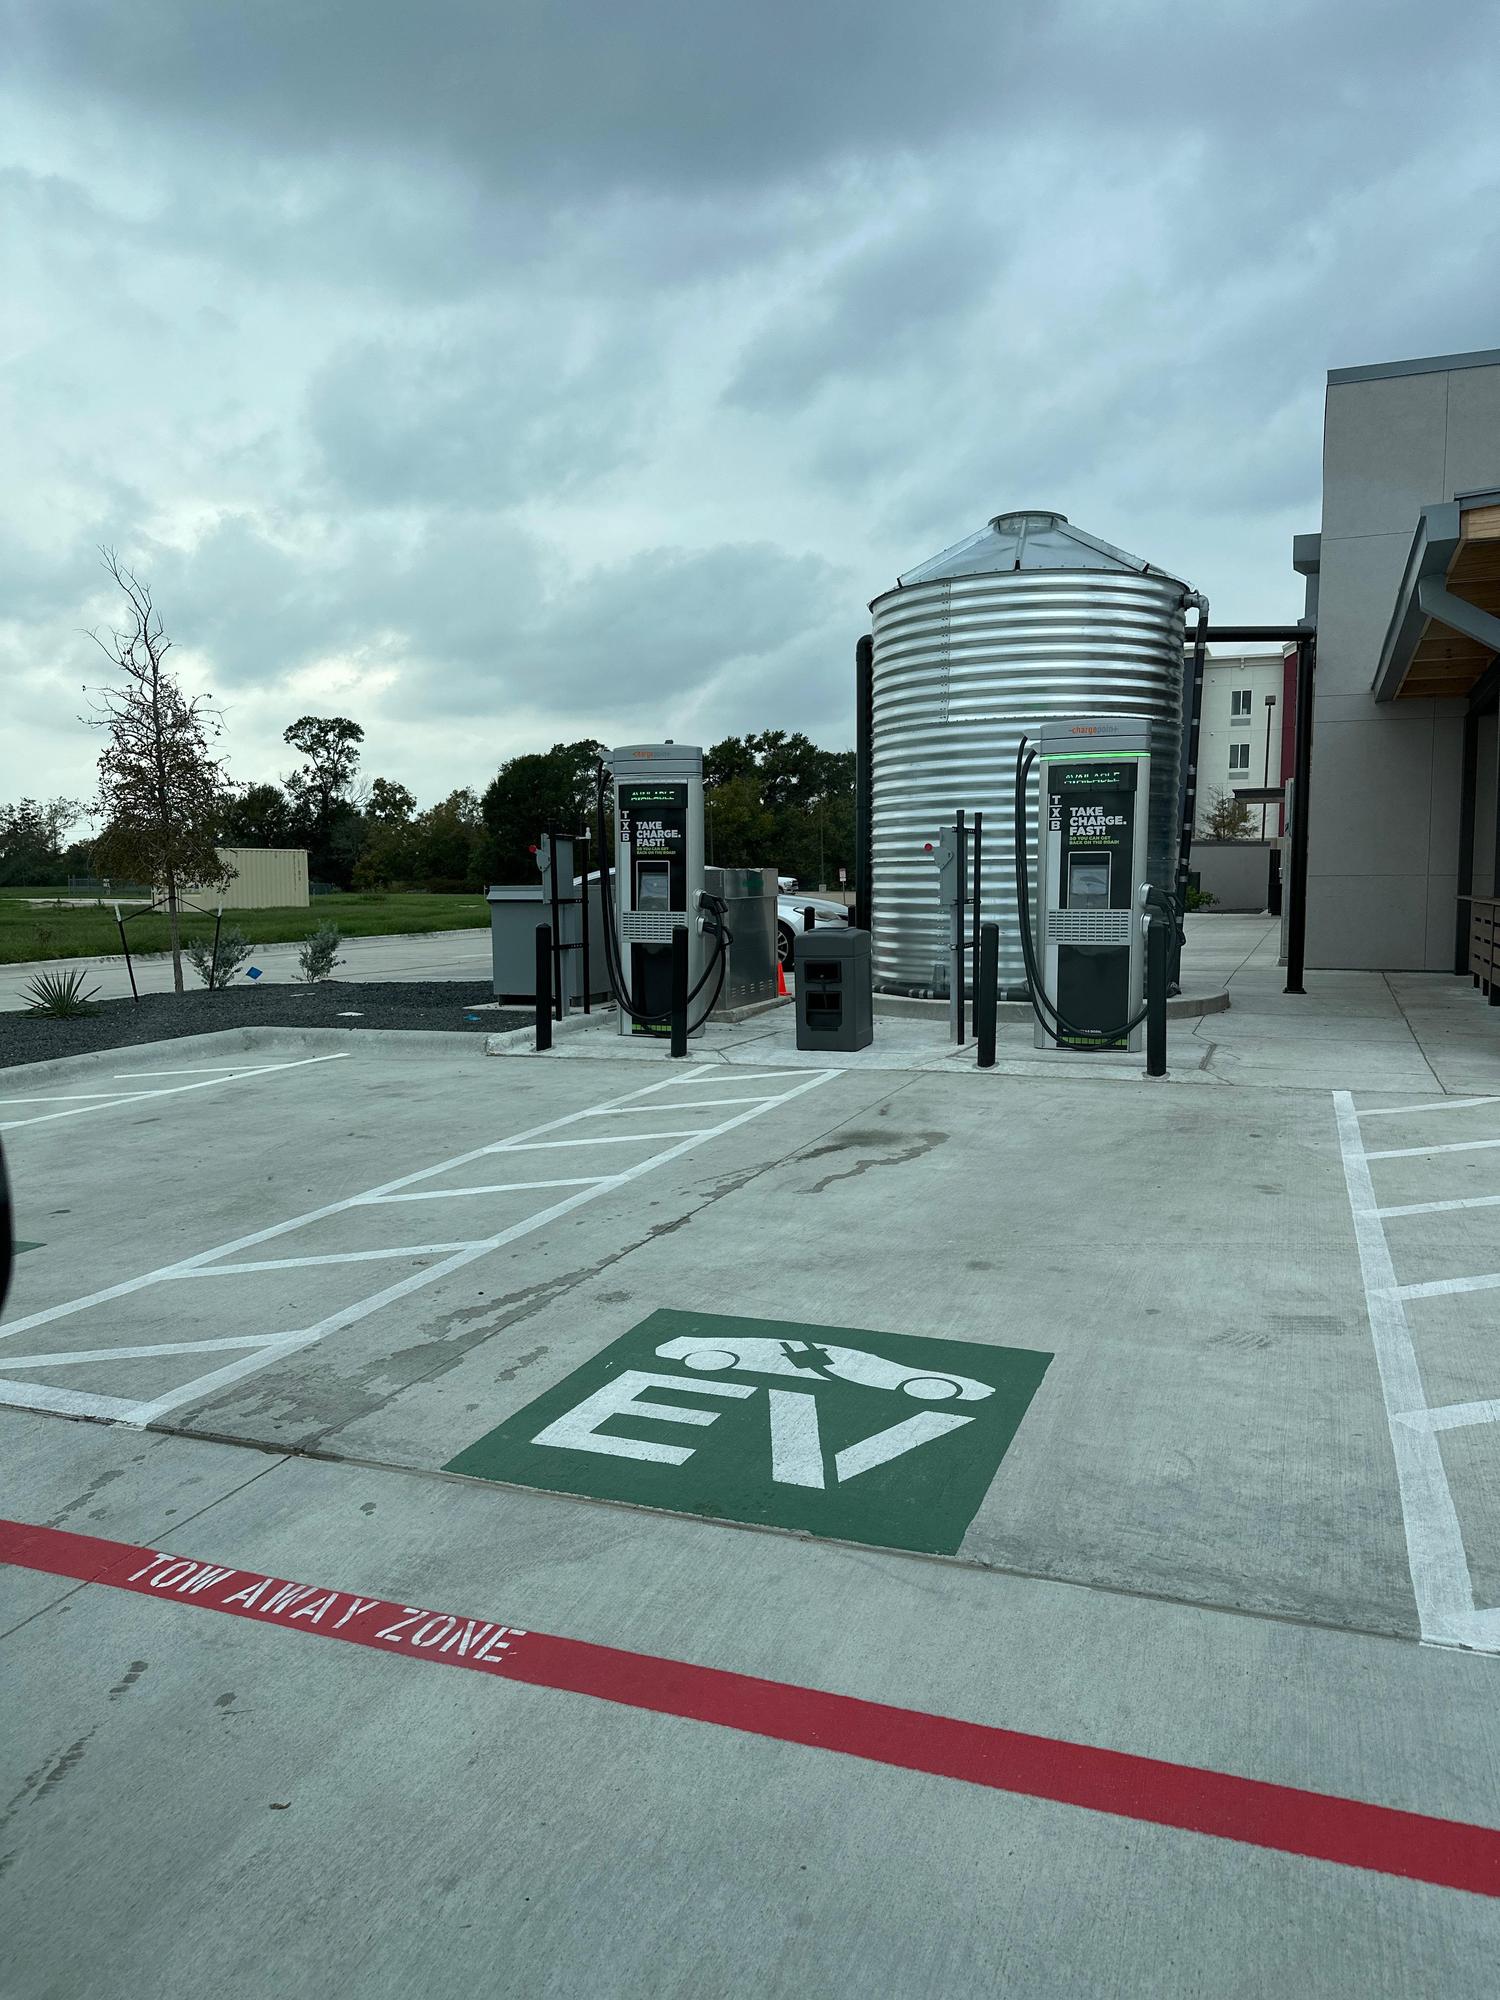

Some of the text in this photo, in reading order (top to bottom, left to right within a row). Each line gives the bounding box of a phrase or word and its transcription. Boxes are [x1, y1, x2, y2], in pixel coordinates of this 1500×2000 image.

[1070, 807, 1103, 816] TAKE
[636, 821, 662, 830] TAKE
[1070, 816, 1127, 826] CHARGE.
[636, 829, 681, 839] CHARGE.
[1069, 826, 1106, 836] FAST!
[636, 839, 665, 847] FAST!
[530, 1369, 976, 1489] EV
[128, 1552, 527, 1663] TOW AWAY ZONE
